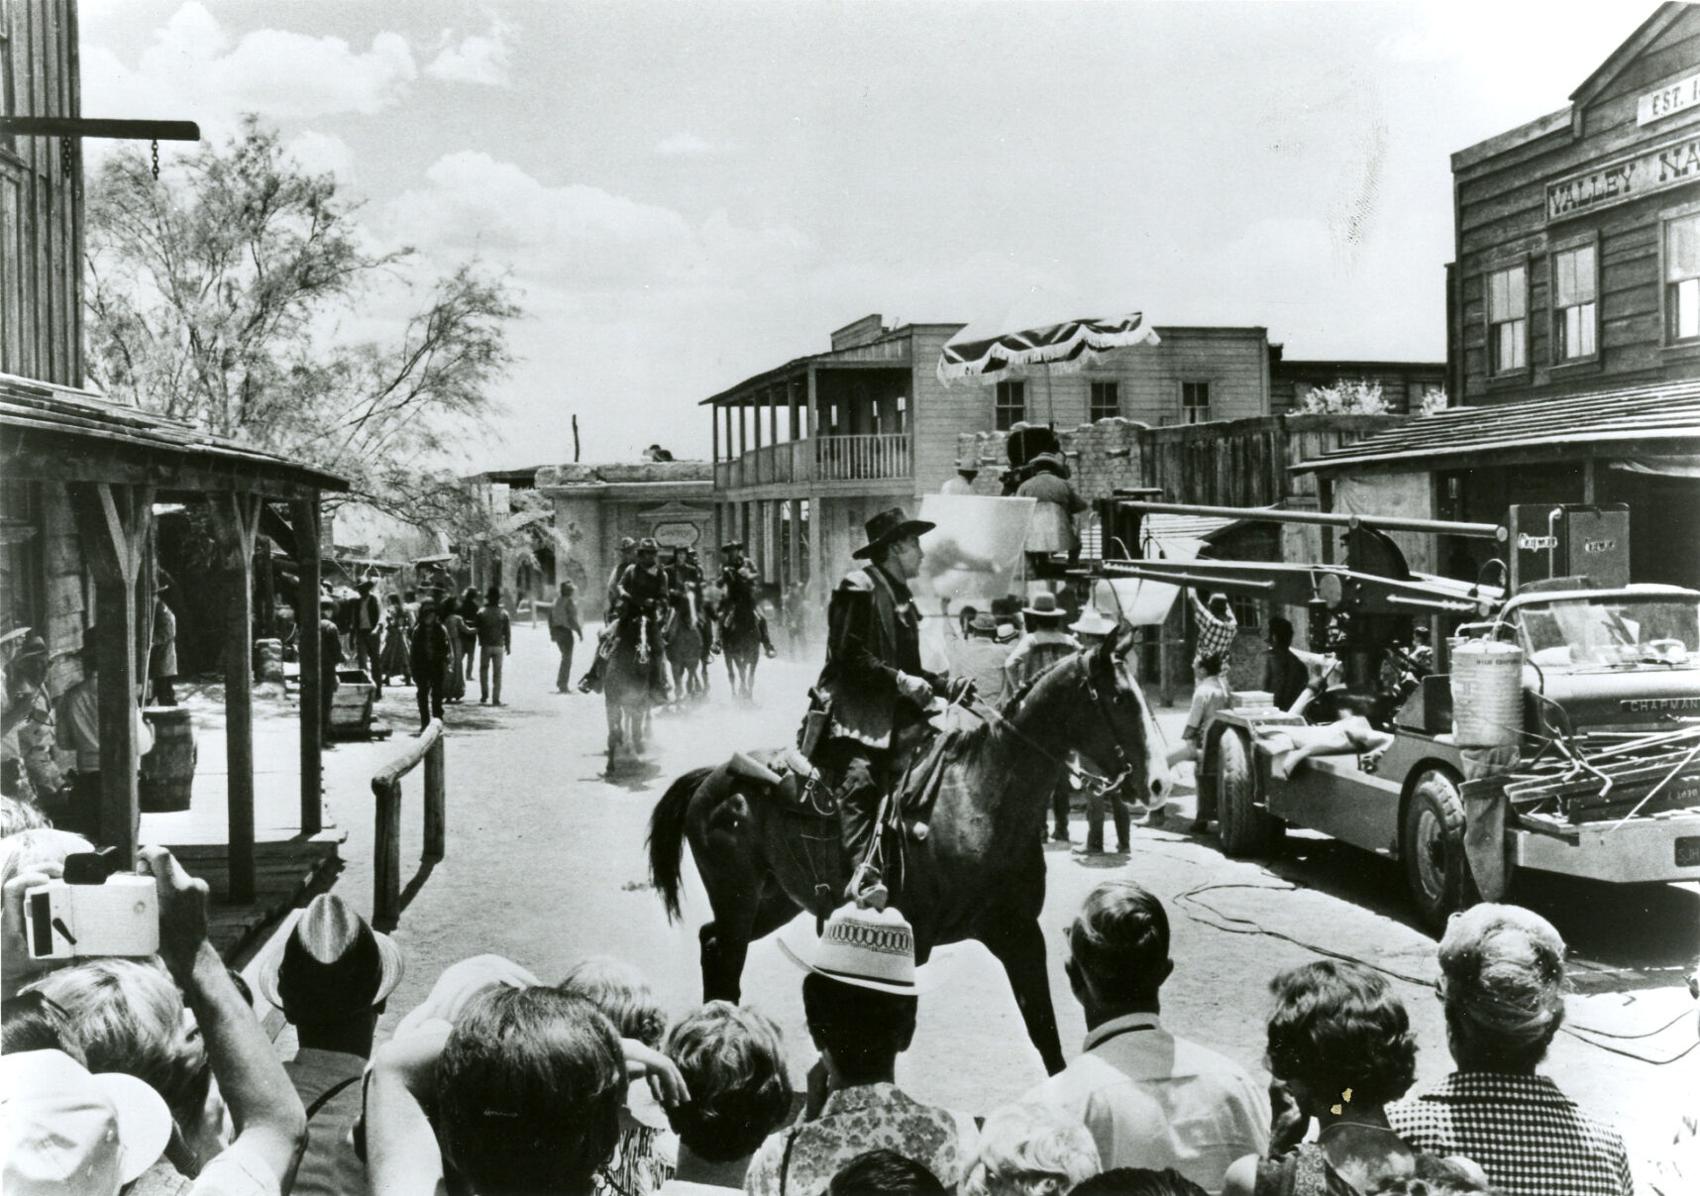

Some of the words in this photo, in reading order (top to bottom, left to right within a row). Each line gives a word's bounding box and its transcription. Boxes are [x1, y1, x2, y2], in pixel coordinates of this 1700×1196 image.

[1652, 86, 1684, 115] EST.
[1692, 79, 1700, 101] 1
[1550, 163, 1636, 215] VALLEY
[1658, 142, 1700, 182] NA
[1630, 698, 1699, 712] CHAPMAN
